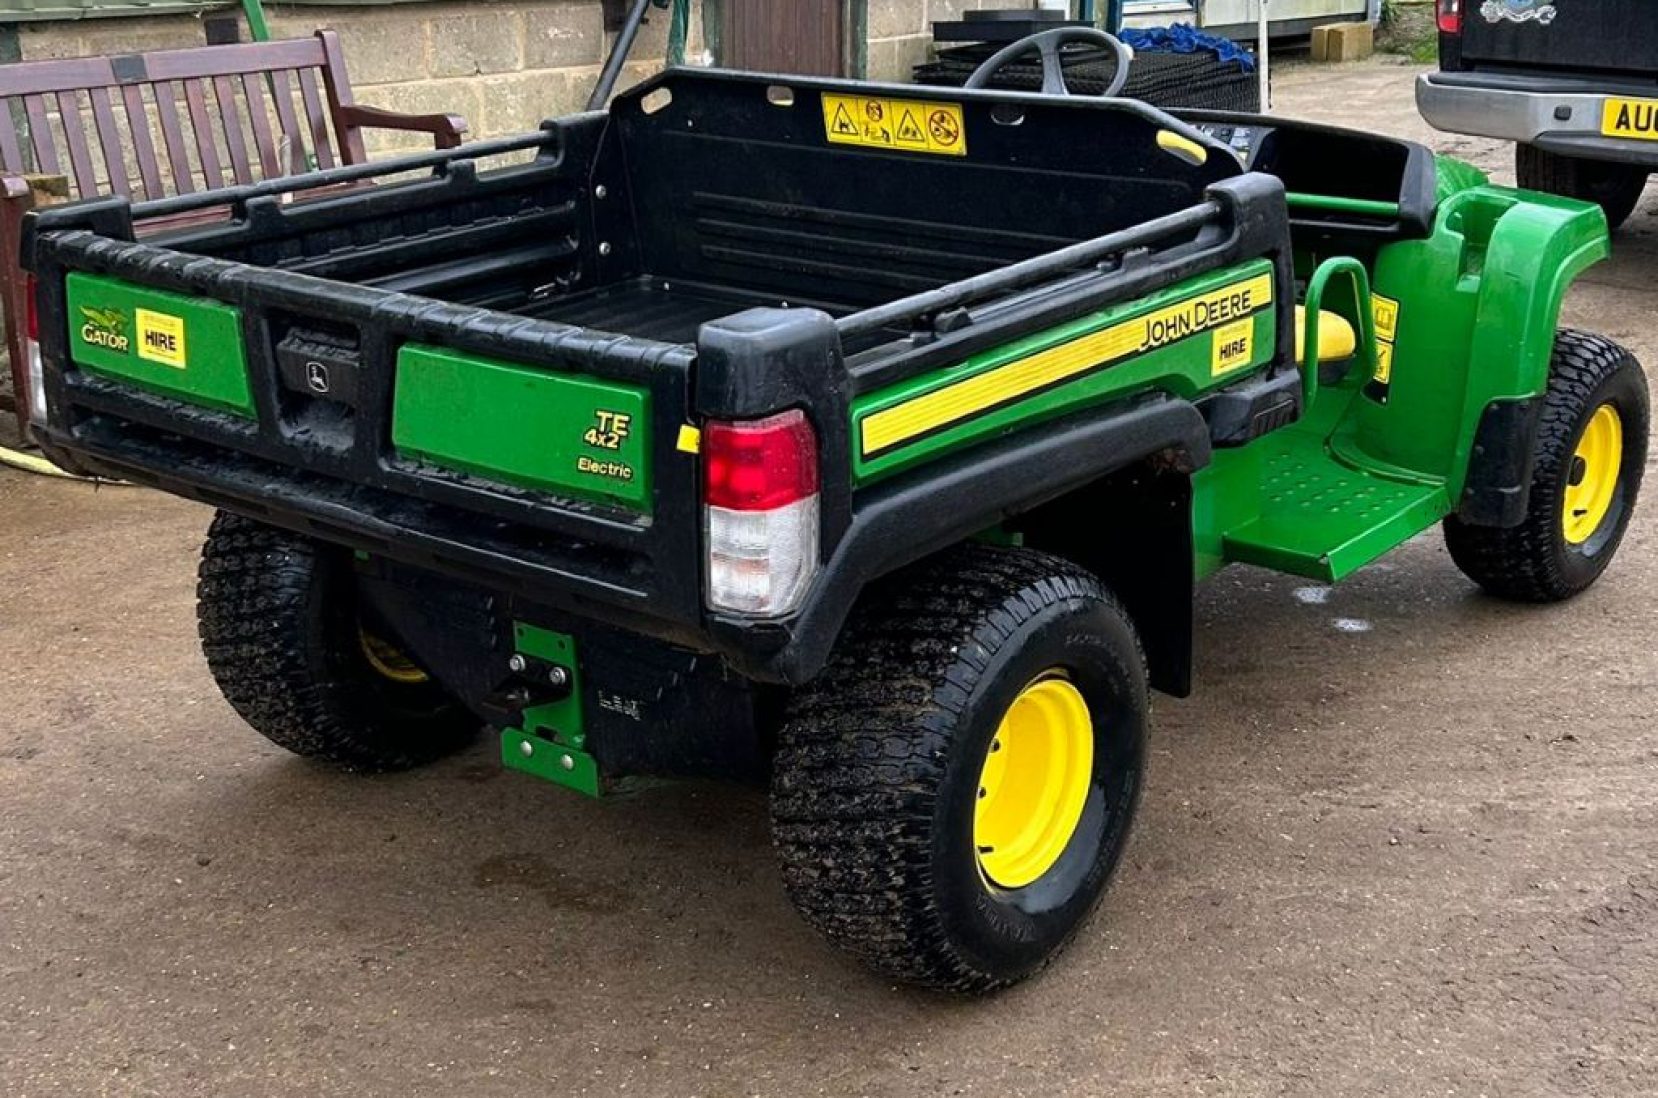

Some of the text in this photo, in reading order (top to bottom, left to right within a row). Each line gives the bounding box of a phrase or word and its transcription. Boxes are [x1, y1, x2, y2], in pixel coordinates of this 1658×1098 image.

[1615, 103, 1658, 132] AU
[1140, 309, 1191, 348] JOHN
[1194, 289, 1251, 328] DEERE
[82, 323, 129, 352] GATOR
[145, 329, 177, 352] HIRE
[1219, 336, 1246, 361] HIRE
[596, 410, 631, 437] TE
[583, 428, 619, 449] 4x2
[577, 456, 632, 479] Electric
